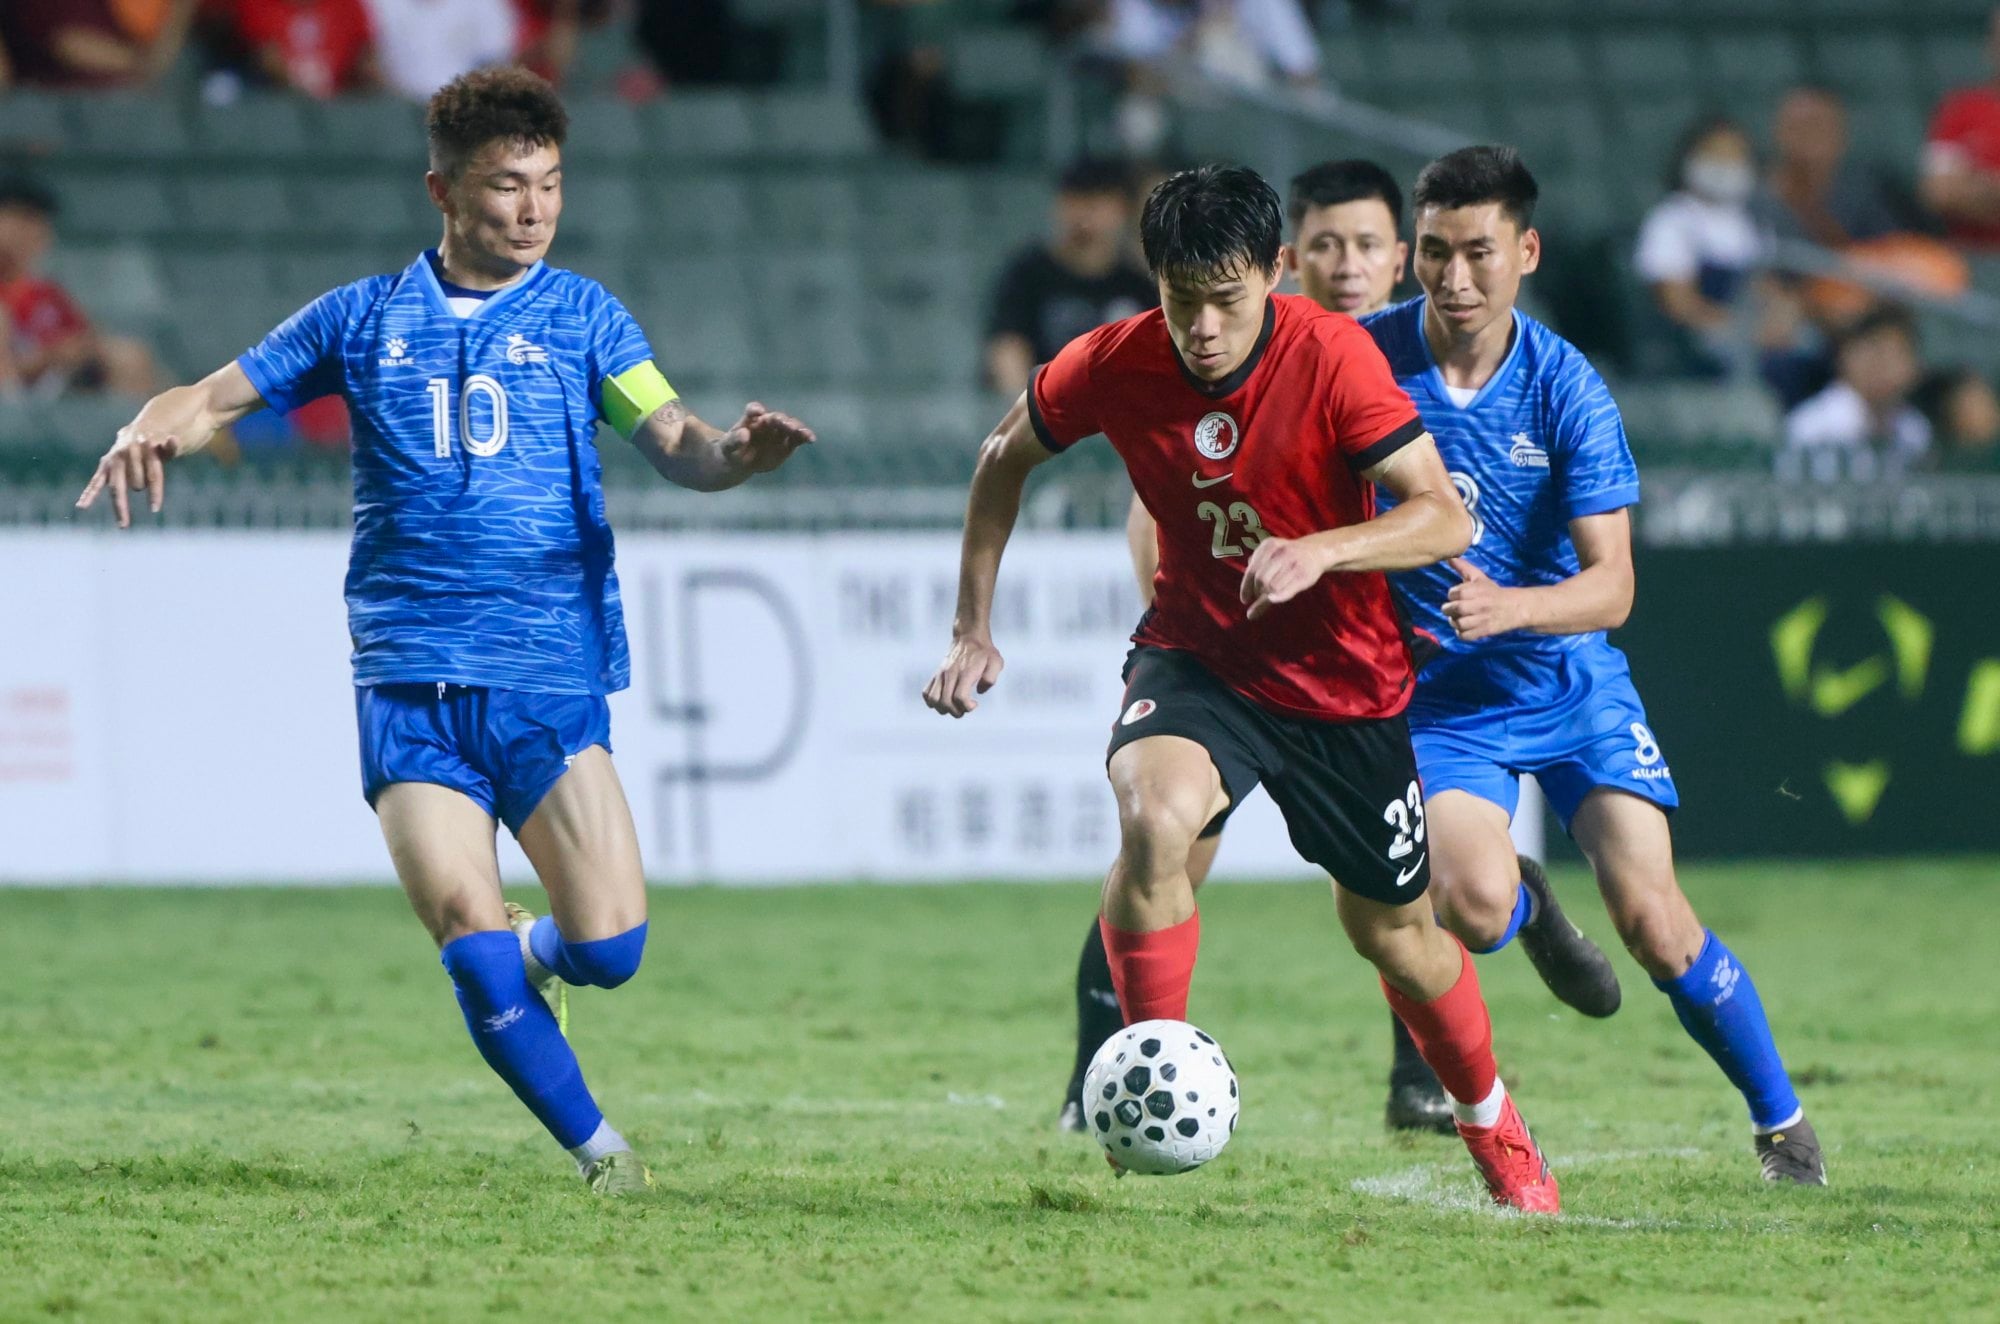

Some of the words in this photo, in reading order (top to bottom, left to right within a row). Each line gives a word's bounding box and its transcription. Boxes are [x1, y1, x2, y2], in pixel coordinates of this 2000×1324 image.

[426, 374, 508, 458] 10
[1197, 501, 1273, 559] 23
[1630, 722, 1660, 766] 8
[1383, 780, 1425, 859] 23
